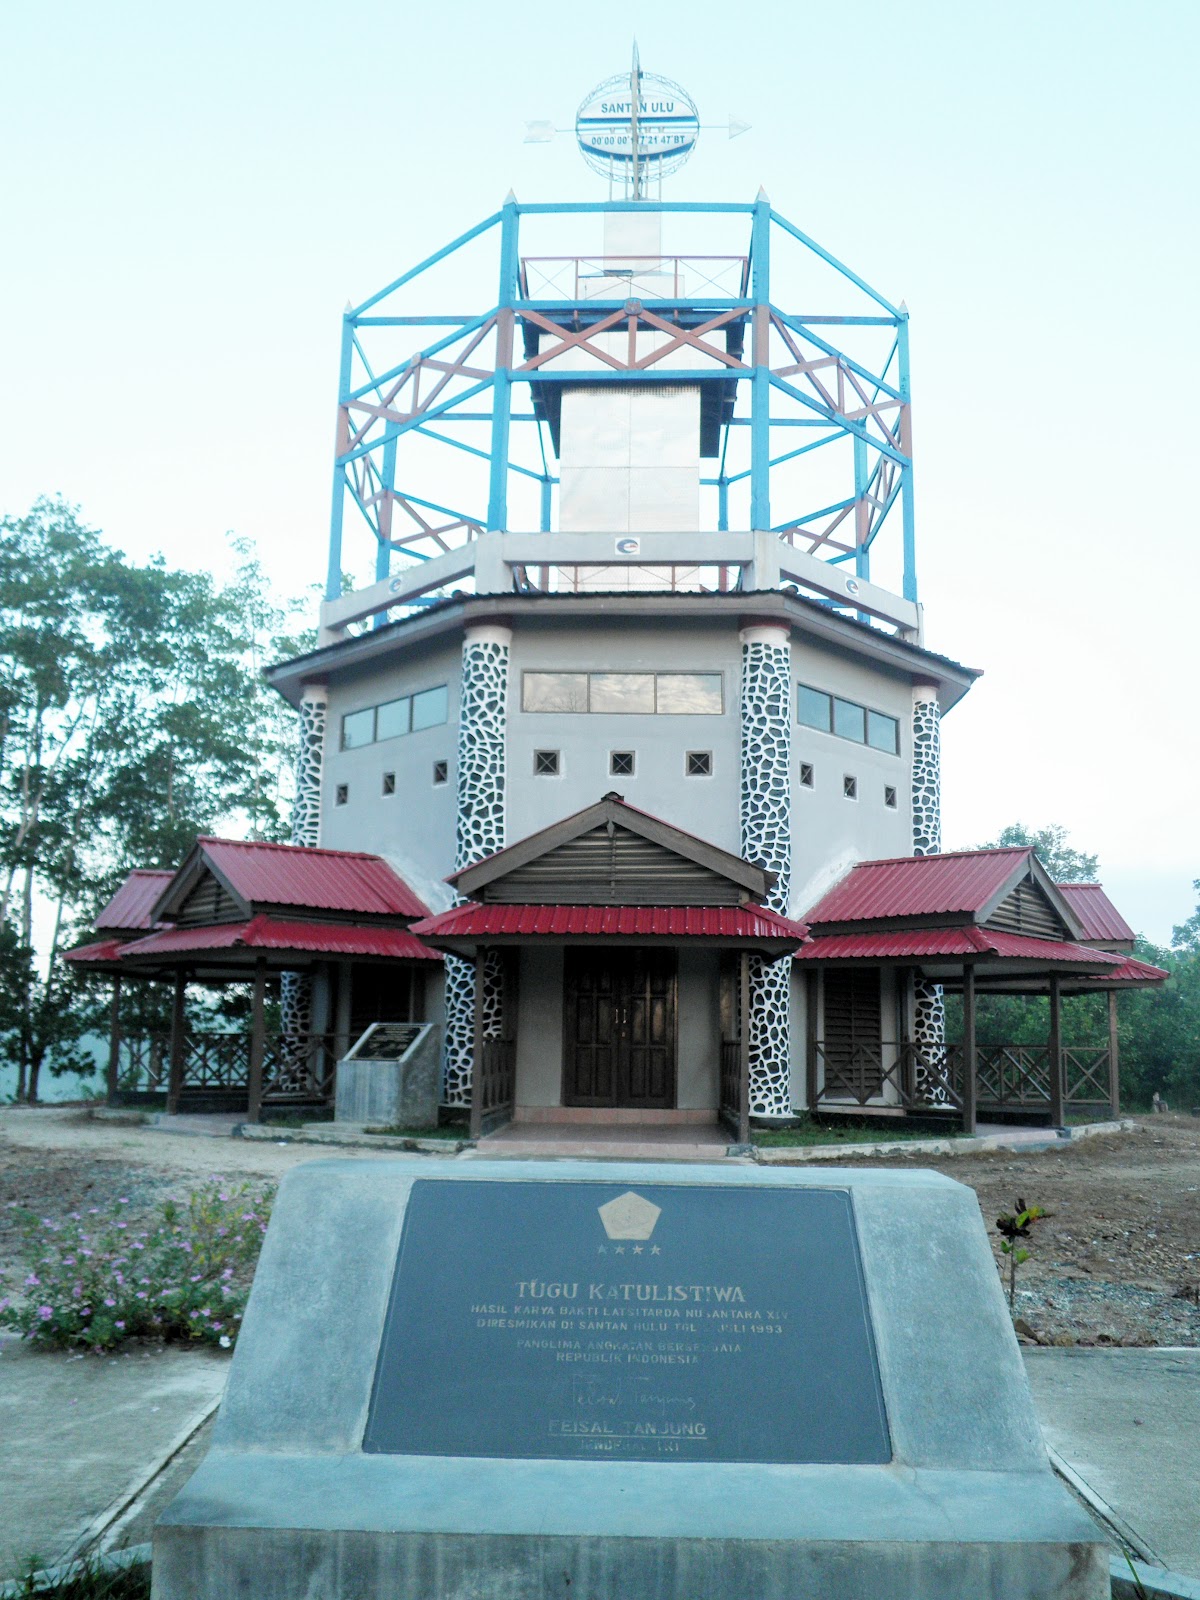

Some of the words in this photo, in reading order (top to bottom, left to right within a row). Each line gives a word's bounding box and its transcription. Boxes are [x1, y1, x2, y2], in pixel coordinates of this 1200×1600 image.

[601, 102, 647, 113] SANTN
[652, 102, 674, 113] ULU
[514, 1280, 580, 1300] TUGU
[588, 1283, 747, 1303] KATULISTIWA
[470, 1304, 508, 1314] HASIL
[514, 1305, 555, 1316] KARYA
[559, 1306, 598, 1316] BAKTI
[603, 1307, 681, 1318] LATSITARDA
[476, 1318, 556, 1329] DIRESMIKAN
[561, 1320, 574, 1330] DI
[579, 1321, 628, 1331] SANTAN
[633, 1322, 667, 1332] HULU
[674, 1323, 697, 1333] TGL
[750, 1324, 783, 1334] 1993
[517, 1339, 581, 1350] PANGLIMA
[587, 1340, 653, 1351] ANGKATAN
[556, 1352, 622, 1363] REPUBLIK
[627, 1353, 699, 1364] INDONESIA
[548, 1419, 613, 1434] FEISAL
[623, 1421, 707, 1436] TANJUNG
